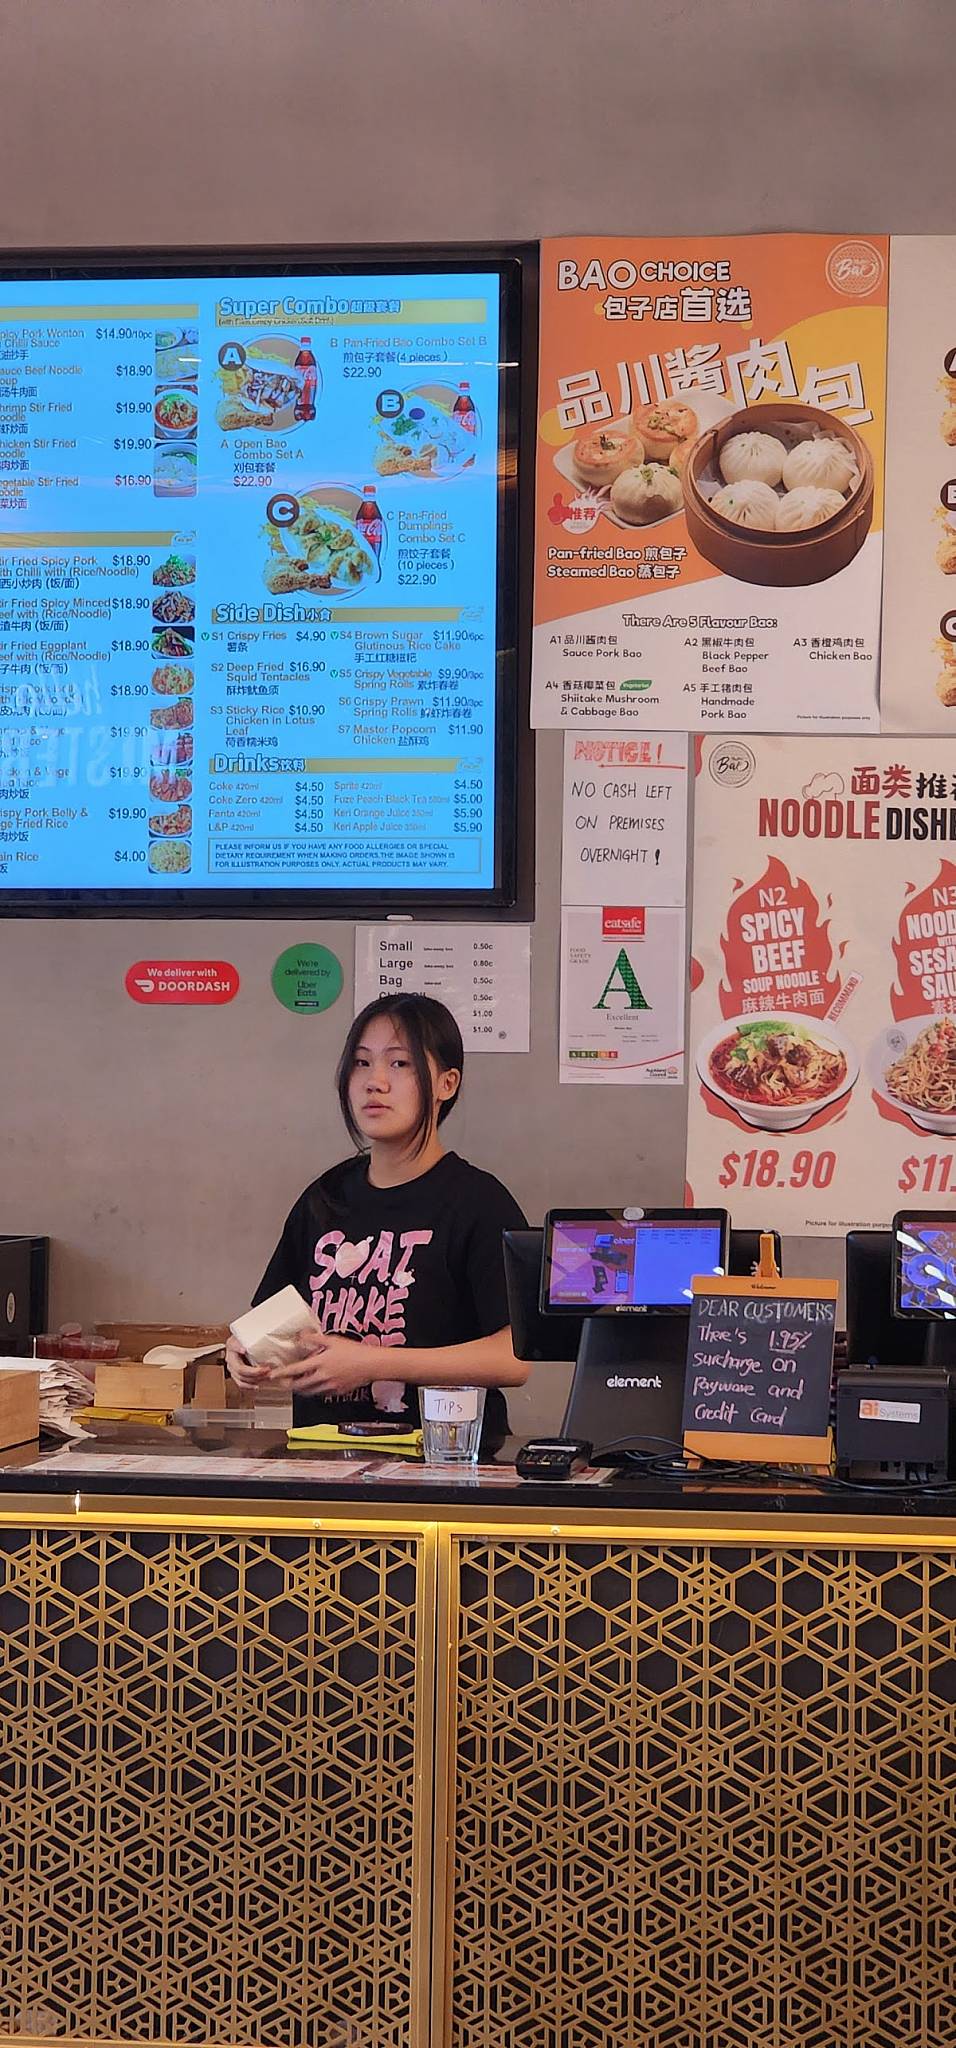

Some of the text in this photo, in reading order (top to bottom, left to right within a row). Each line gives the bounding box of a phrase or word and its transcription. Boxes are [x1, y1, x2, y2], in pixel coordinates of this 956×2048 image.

[557, 260, 730, 291] BAO CHOICE
[219, 296, 350, 320] Super Combo
[602, 288, 753, 322] 包子店首选
[96, 328, 152, 340] $14.90/10pc
[344, 336, 454, 348] Pan-Fried Bao Combo
[116, 366, 153, 378] $18.90
[344, 366, 382, 379] $22.90
[116, 402, 152, 414] $19.90
[114, 439, 152, 451] $19.90
[234, 438, 288, 450] Open Bao
[115, 475, 152, 487] $16.90
[232, 476, 273, 488] $22.90
[548, 547, 688, 561] Pan-fried Bao 煎包子
[113, 555, 151, 567] $18.90
[547, 564, 680, 579] Steamed Bao 蒸包子
[398, 574, 437, 586] $22.90
[113, 598, 150, 610] $18.90
[215, 602, 260, 622] Side
[263, 602, 306, 621] Dish
[622, 614, 778, 629] There Are 5 Flavour Bao:
[296, 631, 326, 642] $4.90
[550, 635, 618, 646] A1 品川酱肉包
[112, 640, 150, 652] $18.90
[684, 638, 755, 648] A2 黑椒牛肉包
[793, 638, 865, 648] A3 香橙鸡肉包
[562, 648, 642, 658] Sauce Pork Bao
[702, 650, 769, 662] Black Pepper
[809, 651, 873, 661] Chicken Bao
[290, 662, 326, 673] $16.90
[702, 664, 748, 673] Beef Bao
[111, 686, 149, 697] $18.90
[545, 681, 558, 690] A4
[682, 684, 697, 692] A5
[561, 694, 660, 704] Shiitake Mushroom
[700, 696, 755, 706] Handmade
[289, 704, 326, 716] $10.90
[560, 707, 639, 718] & Cabbage Bao
[700, 710, 748, 719] Pork Bao
[448, 725, 484, 736] $11.90
[214, 754, 281, 774] Drinks
[717, 756, 749, 775] Bao
[295, 781, 324, 792] $4.50
[454, 779, 484, 790] $4.50
[851, 764, 956, 801] 面类推
[571, 781, 672, 800] NO CASH LEFT
[295, 796, 324, 806] $4.50
[453, 794, 484, 804] $5.00
[109, 808, 147, 820] $19.90
[295, 809, 324, 820] $4.50
[453, 808, 484, 819] $5.90
[758, 798, 880, 840] NOODLE
[294, 822, 324, 834] $4.50
[453, 822, 484, 833] $5.90
[576, 815, 665, 832] ON PREMISES
[115, 851, 146, 863] $4.00
[580, 847, 648, 864] OVERNIGHT
[758, 886, 789, 909] N2
[604, 916, 642, 930] eatsafe
[740, 907, 806, 944] SPICY
[380, 940, 413, 952] Small
[752, 940, 806, 975] BEEF
[380, 958, 414, 971] Large
[473, 960, 493, 968] 0.80c
[147, 967, 218, 977] We deliver with
[284, 968, 331, 978] delivered by
[297, 980, 318, 988] Uber
[380, 975, 403, 988] Bag
[592, 947, 653, 1010] A
[743, 970, 821, 995] SOUP NOODLE
[159, 980, 231, 992] DOORDASH
[297, 989, 318, 997] Eats
[742, 988, 825, 1015] 麻辣牛肉面
[473, 1010, 493, 1018] $1.00
[606, 1013, 639, 1021] Excellent
[473, 1026, 493, 1034] $1.00
[719, 1150, 837, 1190] $18.90
[616, 1304, 648, 1312] element
[698, 1298, 835, 1323] DEAR CUSTOMERS
[697, 1322, 813, 1352] There's 1.95%
[692, 1350, 797, 1377] surcharge on
[606, 1375, 663, 1389] element
[692, 1376, 804, 1400] Paywave and
[434, 1398, 463, 1416] Tips
[695, 1401, 740, 1424] Credit
[880, 1407, 919, 1421] Systems
